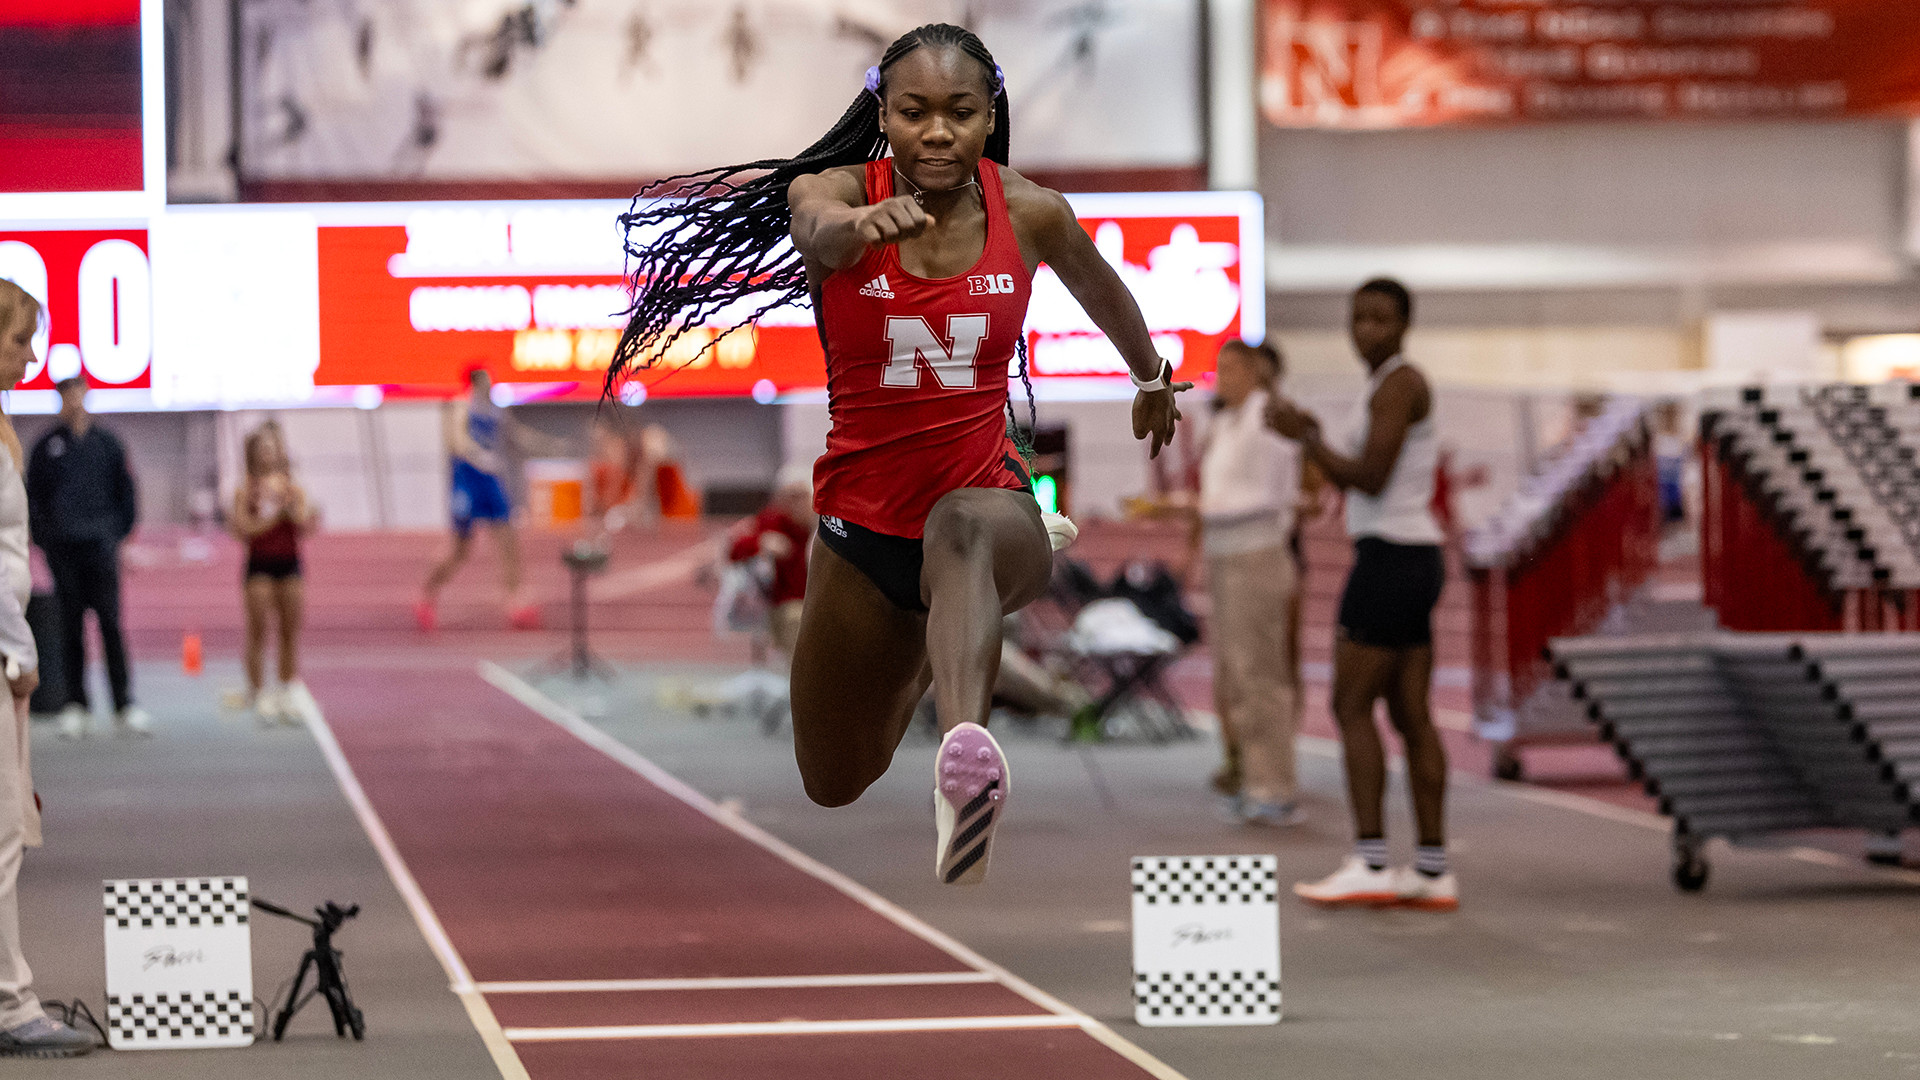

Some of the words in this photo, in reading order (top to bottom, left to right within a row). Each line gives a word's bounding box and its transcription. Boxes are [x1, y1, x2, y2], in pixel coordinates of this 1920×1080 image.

[859, 286, 895, 300] adidas
[880, 313, 990, 390] N
[821, 515, 848, 538] adidas
